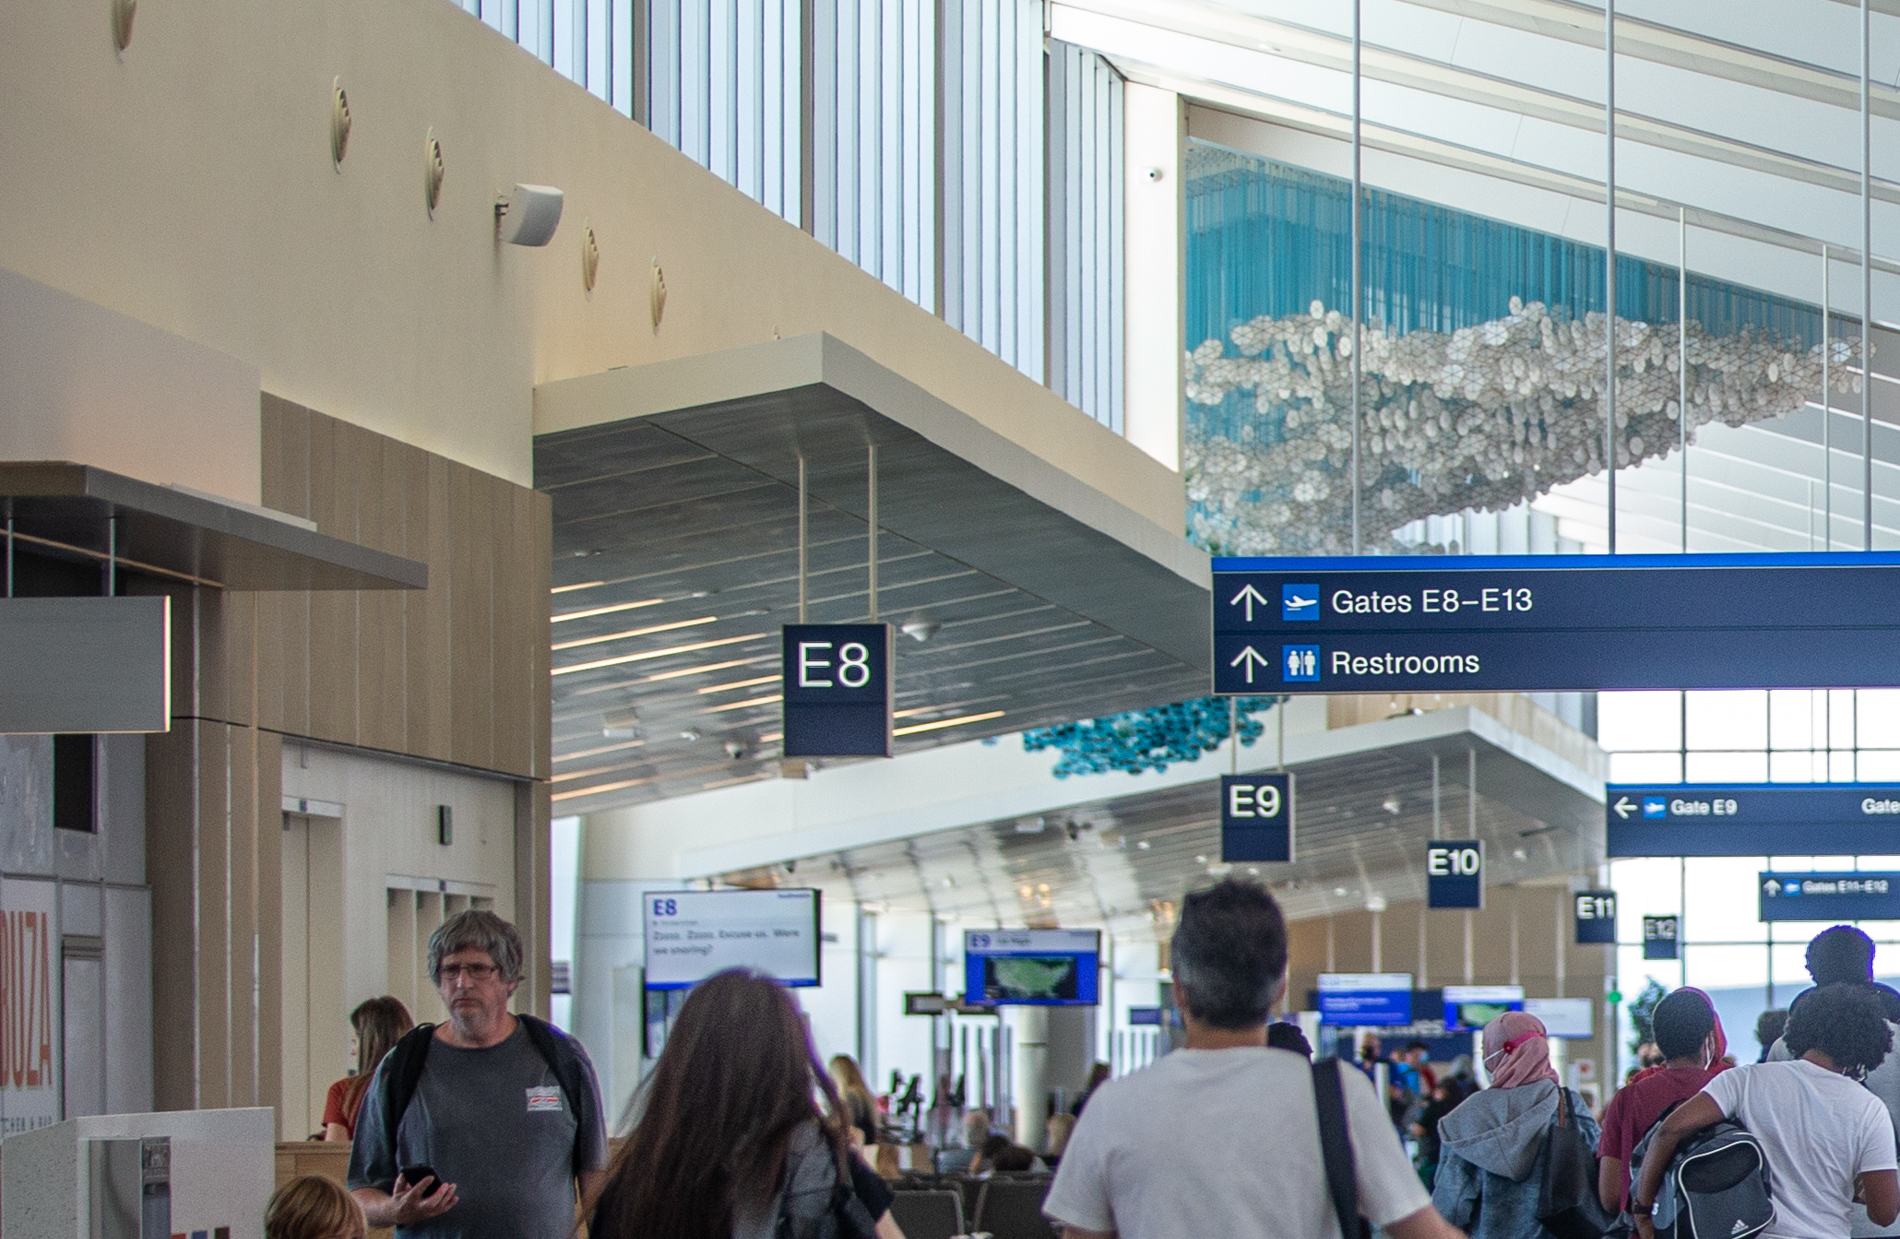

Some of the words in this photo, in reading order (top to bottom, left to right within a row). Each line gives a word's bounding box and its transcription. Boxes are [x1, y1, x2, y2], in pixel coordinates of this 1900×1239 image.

[1331, 589, 1412, 615] Gates
[798, 641, 871, 688] E8
[1331, 651, 1480, 676] Restrooms
[1229, 784, 1282, 818] E9
[1670, 799, 1711, 816] Gate
[1712, 799, 1738, 816] E9
[1427, 848, 1481, 876] E10
[1801, 880, 1837, 894] Gates
[653, 898, 678, 916] E8
[1576, 896, 1615, 920] E11
[1644, 919, 1676, 940] E12
